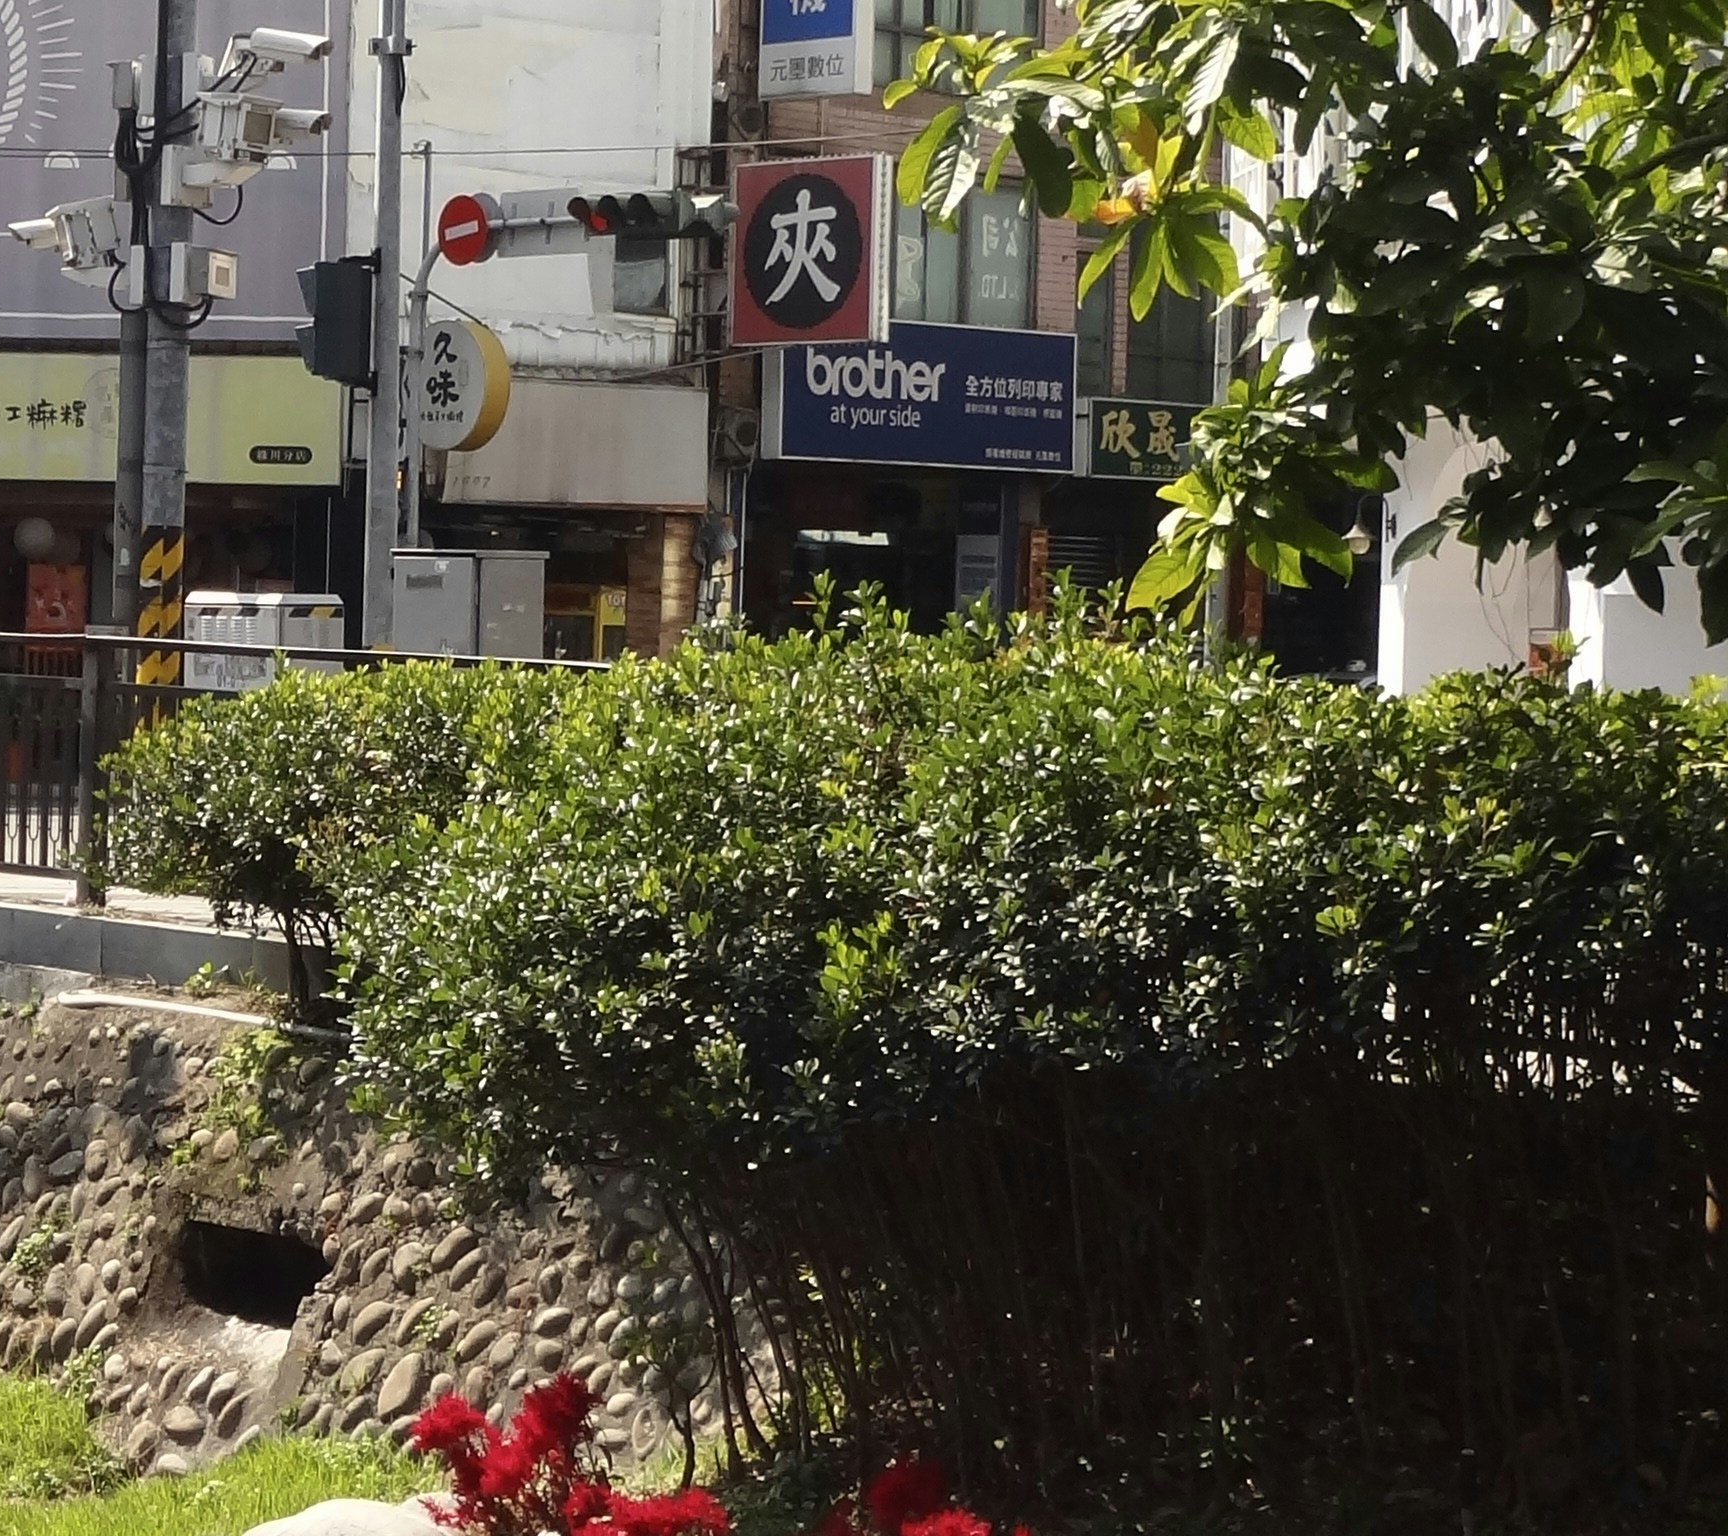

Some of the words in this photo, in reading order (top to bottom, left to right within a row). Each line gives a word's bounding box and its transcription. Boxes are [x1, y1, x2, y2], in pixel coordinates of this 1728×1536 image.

[764, 188, 843, 306] 夾
[426, 331, 460, 408] 久味
[806, 345, 946, 403] brother
[965, 375, 1063, 402] 全方位列印專家
[830, 403, 846, 424] at
[850, 407, 885, 430] your
[889, 404, 921, 428] side
